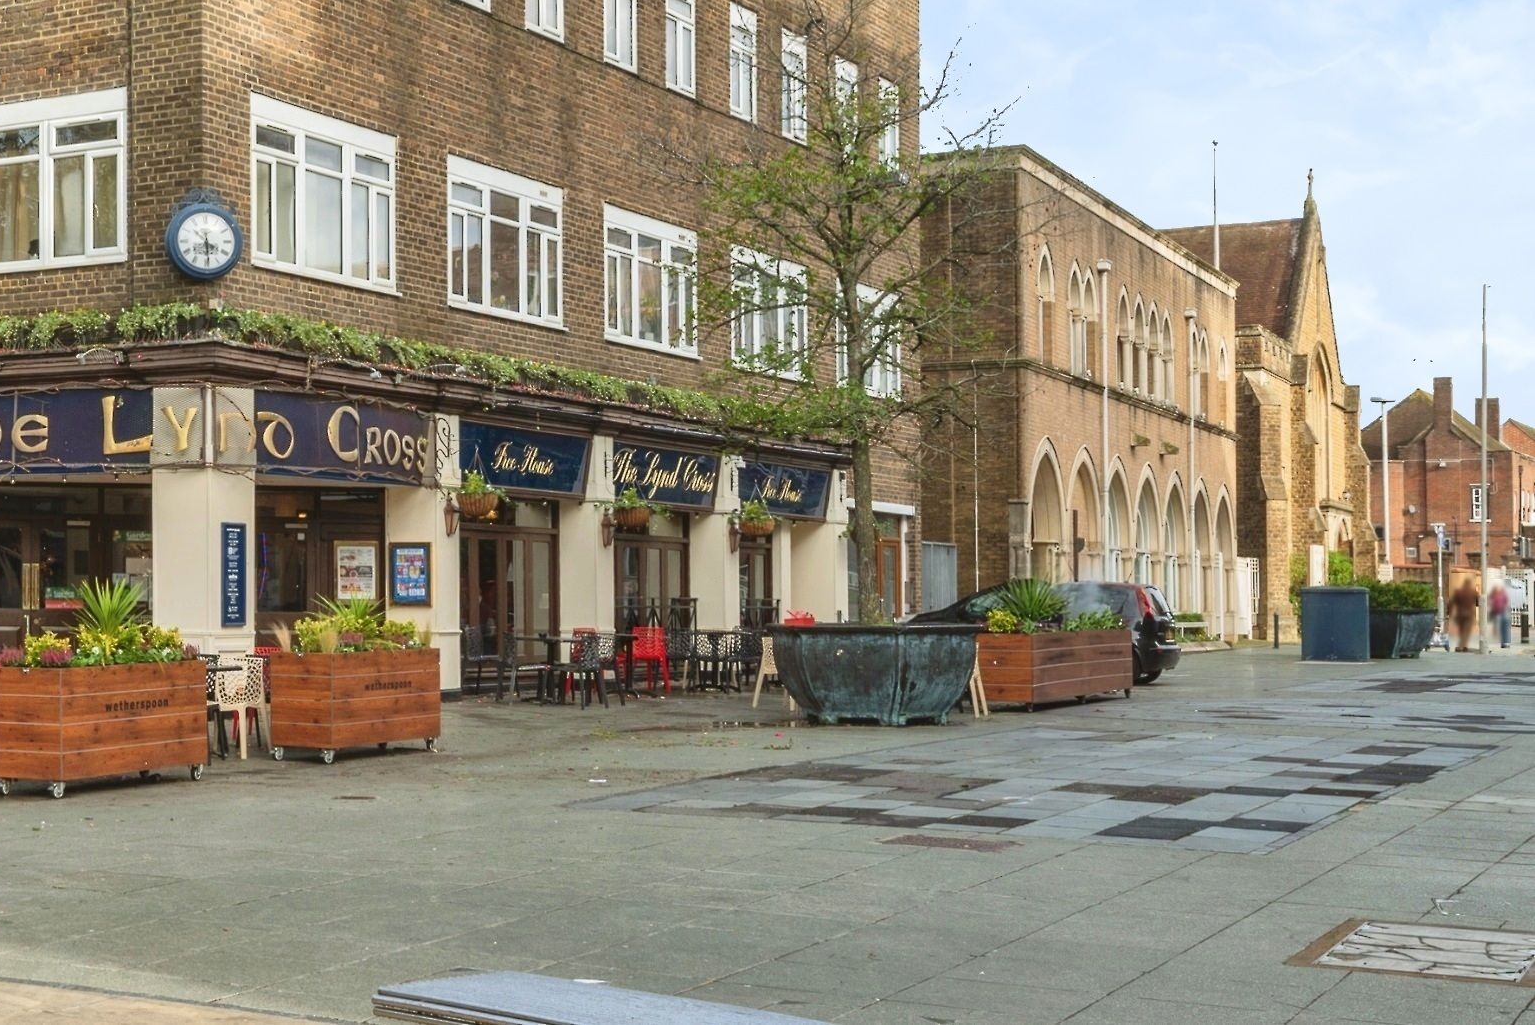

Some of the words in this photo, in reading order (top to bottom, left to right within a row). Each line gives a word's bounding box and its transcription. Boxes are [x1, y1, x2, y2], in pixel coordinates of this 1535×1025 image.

[490, 441, 517, 473] Free
[518, 443, 555, 476] House
[613, 447, 638, 484] The
[638, 450, 684, 500] Lynd
[683, 455, 716, 493] Cross
[364, 678, 412, 691] wetherspoon
[105, 698, 169, 712] wetherspoon
